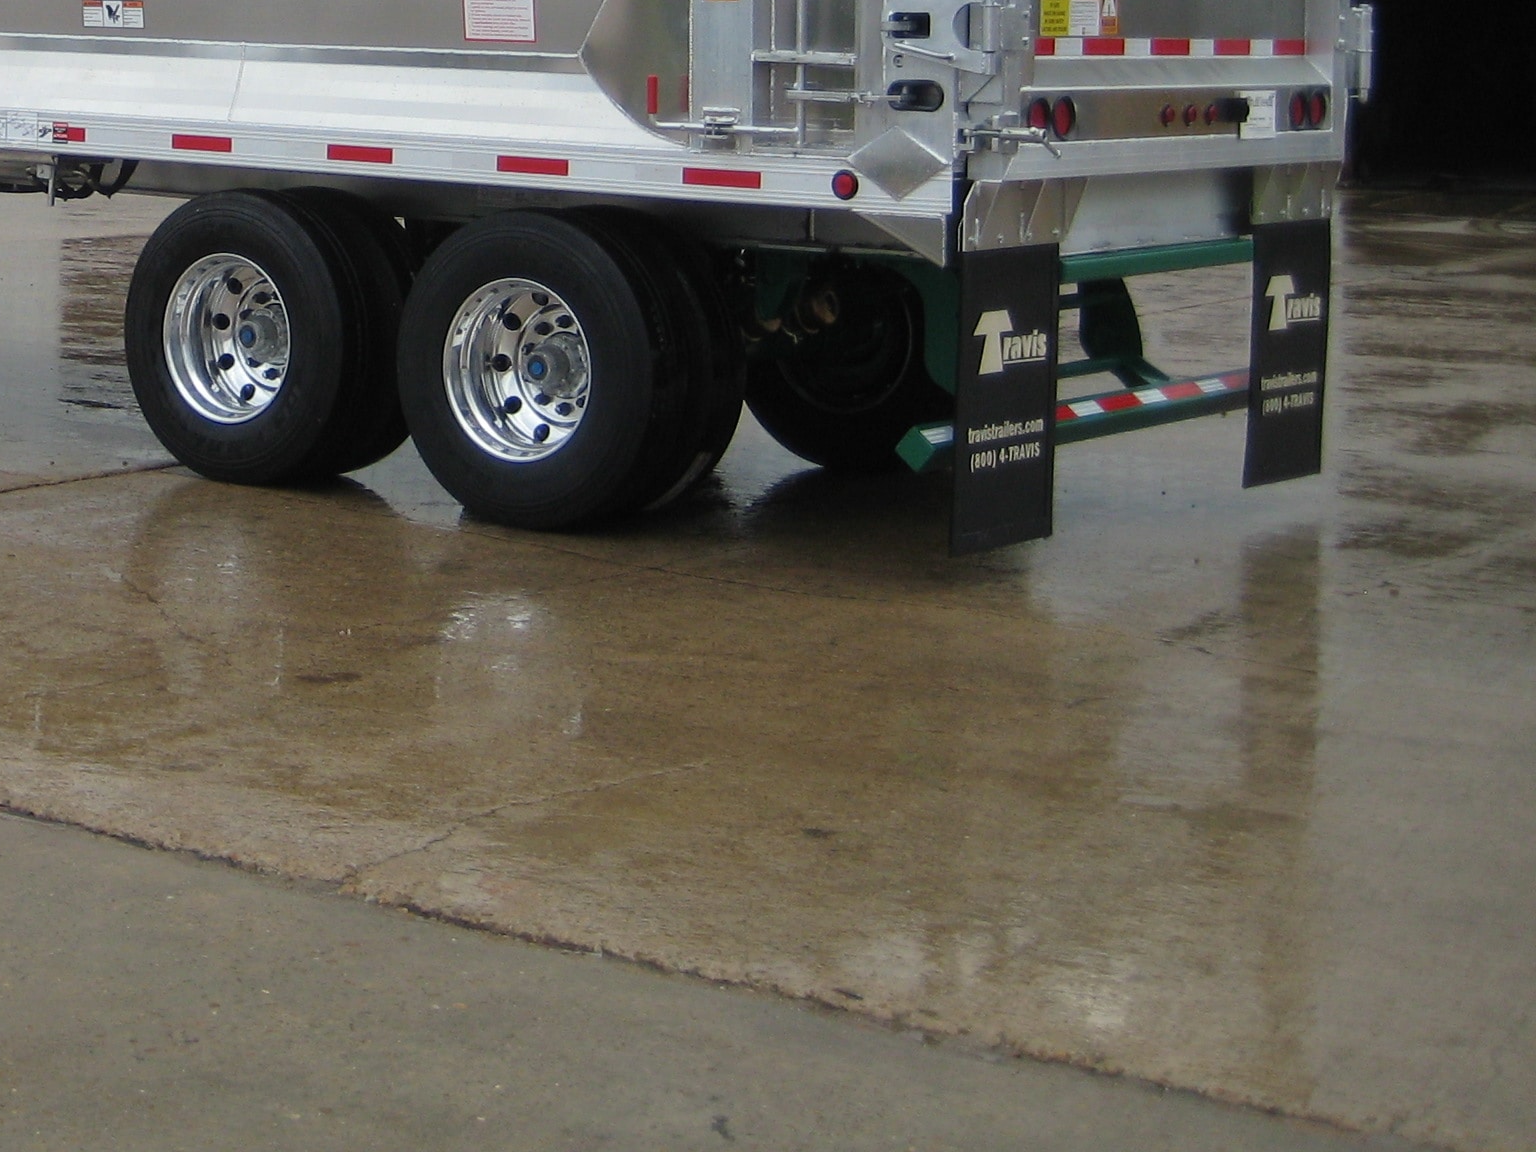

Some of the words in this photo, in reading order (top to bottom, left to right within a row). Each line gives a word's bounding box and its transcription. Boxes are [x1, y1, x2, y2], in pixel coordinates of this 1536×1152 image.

[1265, 274, 1321, 331] Travis
[973, 309, 1047, 376] Travis
[968, 418, 1044, 444] travistrailers.com
[970, 449, 997, 473] (800)
[999, 441, 1041, 465] 4-TRAVIS
